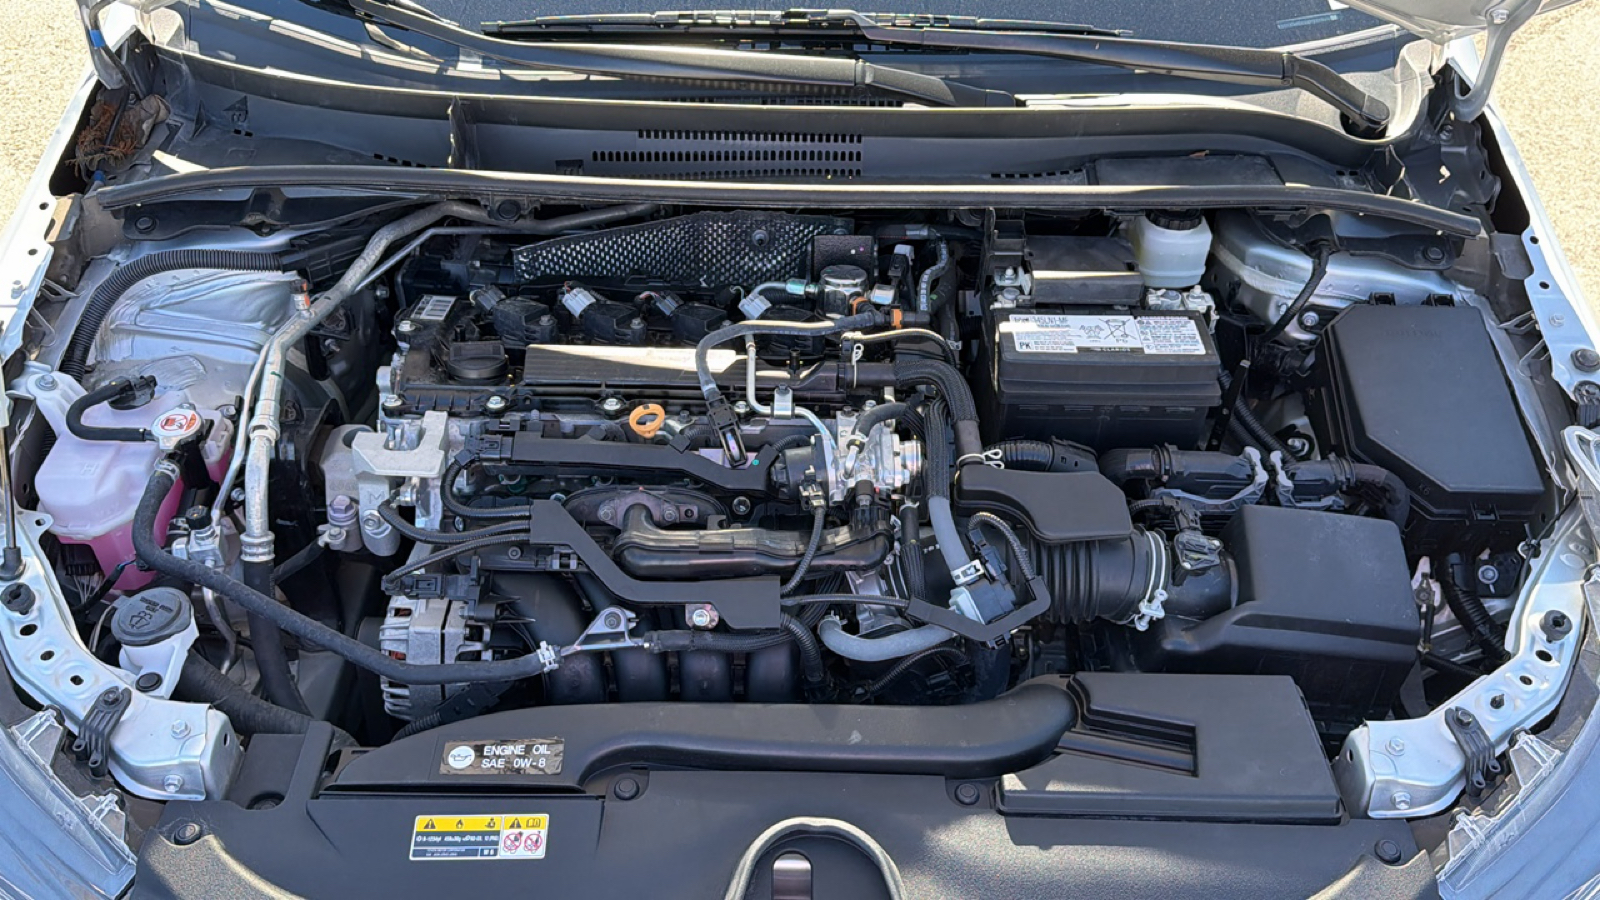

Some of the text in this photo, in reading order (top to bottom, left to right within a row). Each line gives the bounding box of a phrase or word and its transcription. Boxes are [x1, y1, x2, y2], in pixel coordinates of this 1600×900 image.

[483, 744, 551, 756] ENGINE OIL
[481, 758, 547, 768] SAE 0W-8
